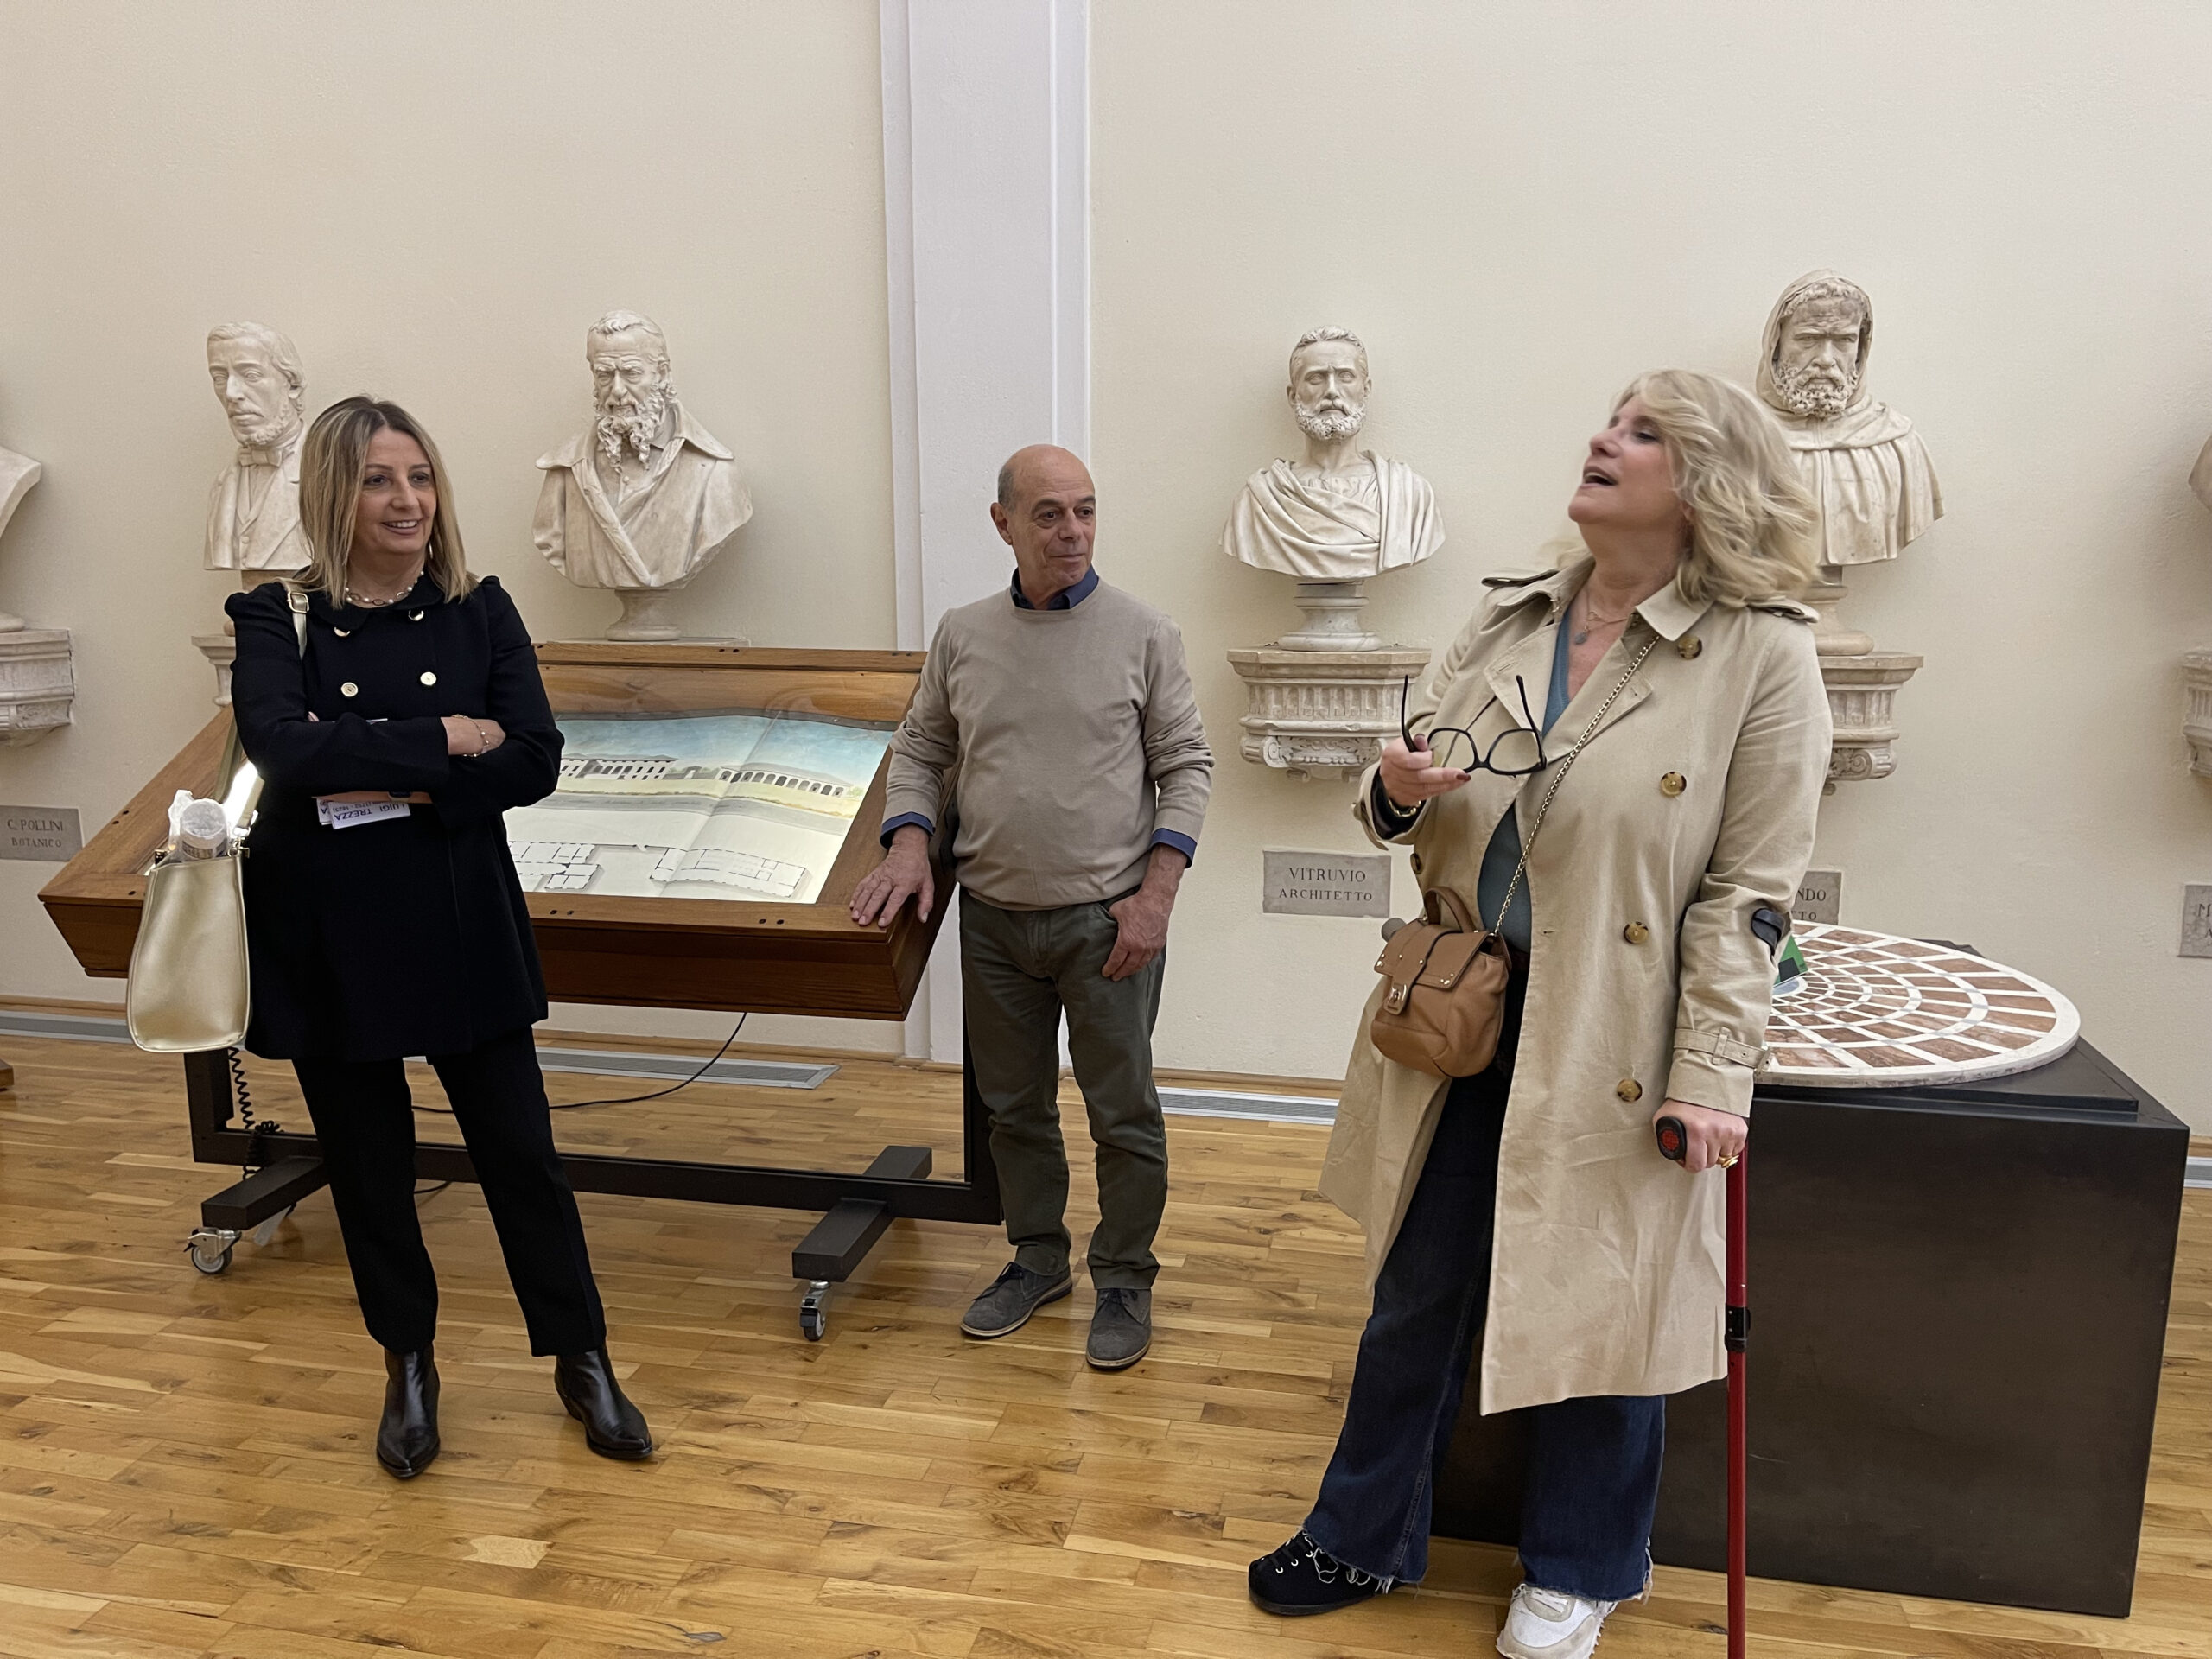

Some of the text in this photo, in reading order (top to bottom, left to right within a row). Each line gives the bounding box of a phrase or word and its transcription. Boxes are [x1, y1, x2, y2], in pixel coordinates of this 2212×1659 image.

[334, 809, 372, 820] TREZZA
[21, 819, 63, 831] POLLINI
[11, 837, 61, 848] BOTANICO
[1289, 868, 1366, 882] VITRUVIO
[1279, 888, 1372, 901] ARCHITETTO
[1796, 888, 1827, 901] NDO
[1791, 911, 1817, 921] TO
